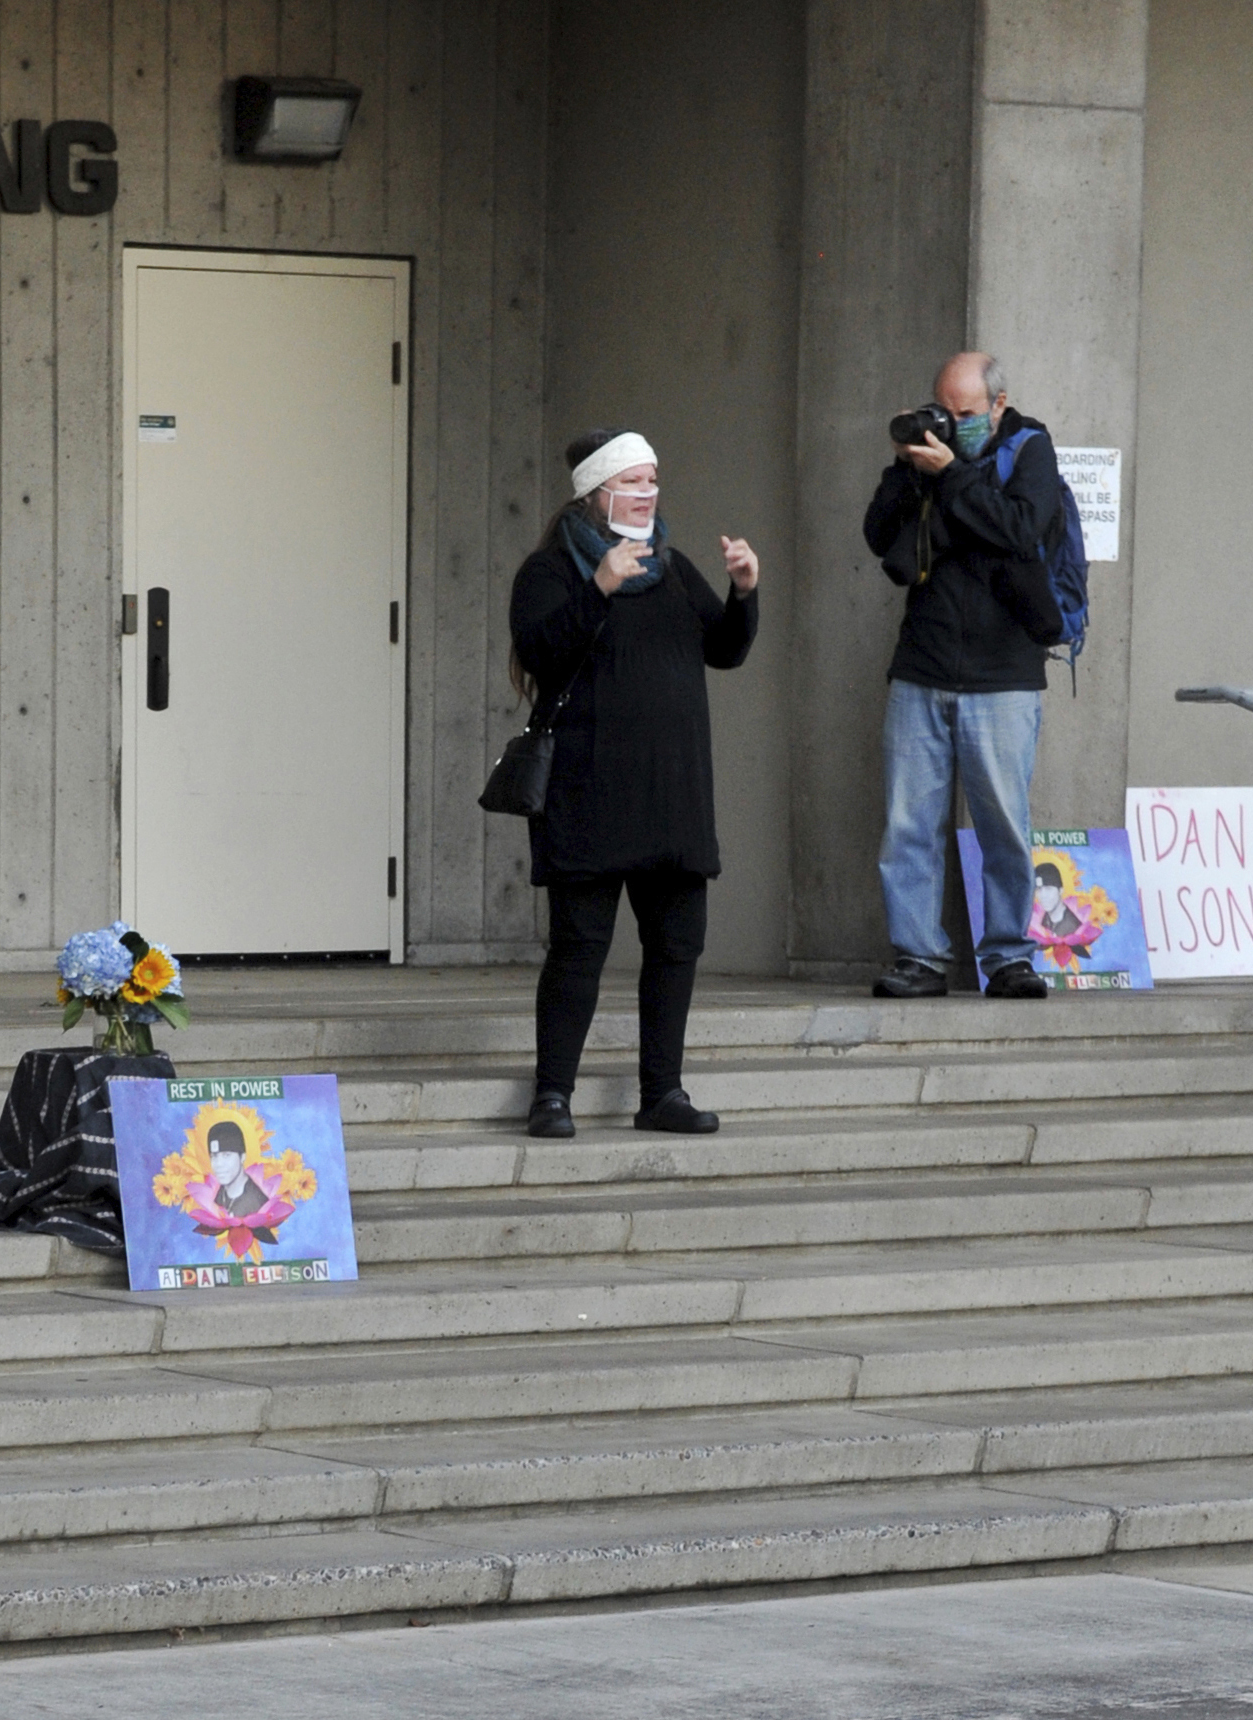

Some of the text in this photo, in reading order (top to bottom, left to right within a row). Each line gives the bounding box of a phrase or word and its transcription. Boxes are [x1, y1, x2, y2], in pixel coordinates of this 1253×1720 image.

[1062, 471, 1097, 485] CLING
[1097, 492, 1111, 504] BE
[1033, 831, 1087, 845] IN POWER
[1136, 803, 1246, 868] IDAN
[170, 1080, 280, 1099] REST IN POWER
